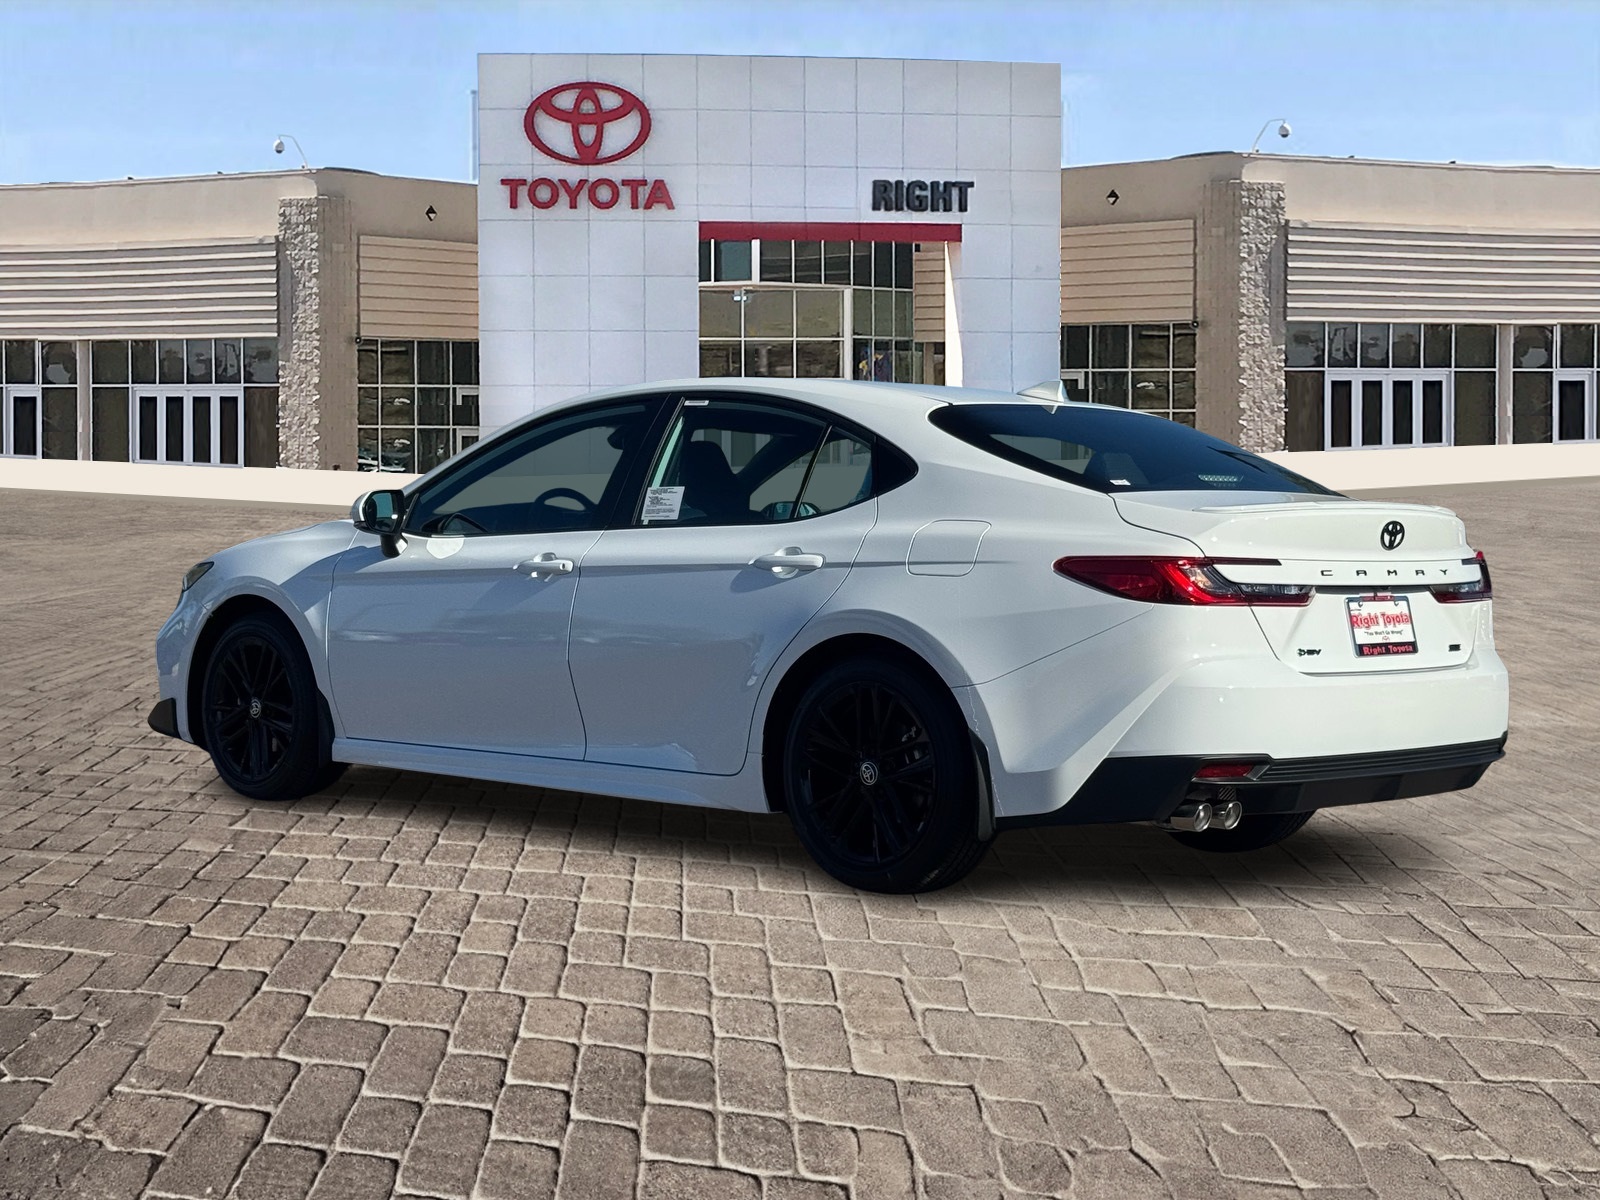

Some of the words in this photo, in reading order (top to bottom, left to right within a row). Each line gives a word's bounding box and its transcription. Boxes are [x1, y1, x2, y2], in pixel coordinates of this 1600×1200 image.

[500, 178, 675, 210] TOYOTA
[872, 179, 975, 212] RIGHT
[1320, 569, 1448, 577] CAMRY
[1351, 612, 1379, 629] Right
[1380, 611, 1410, 628] Toyota
[1363, 645, 1386, 655] Right
[1388, 644, 1414, 653] Toyota
